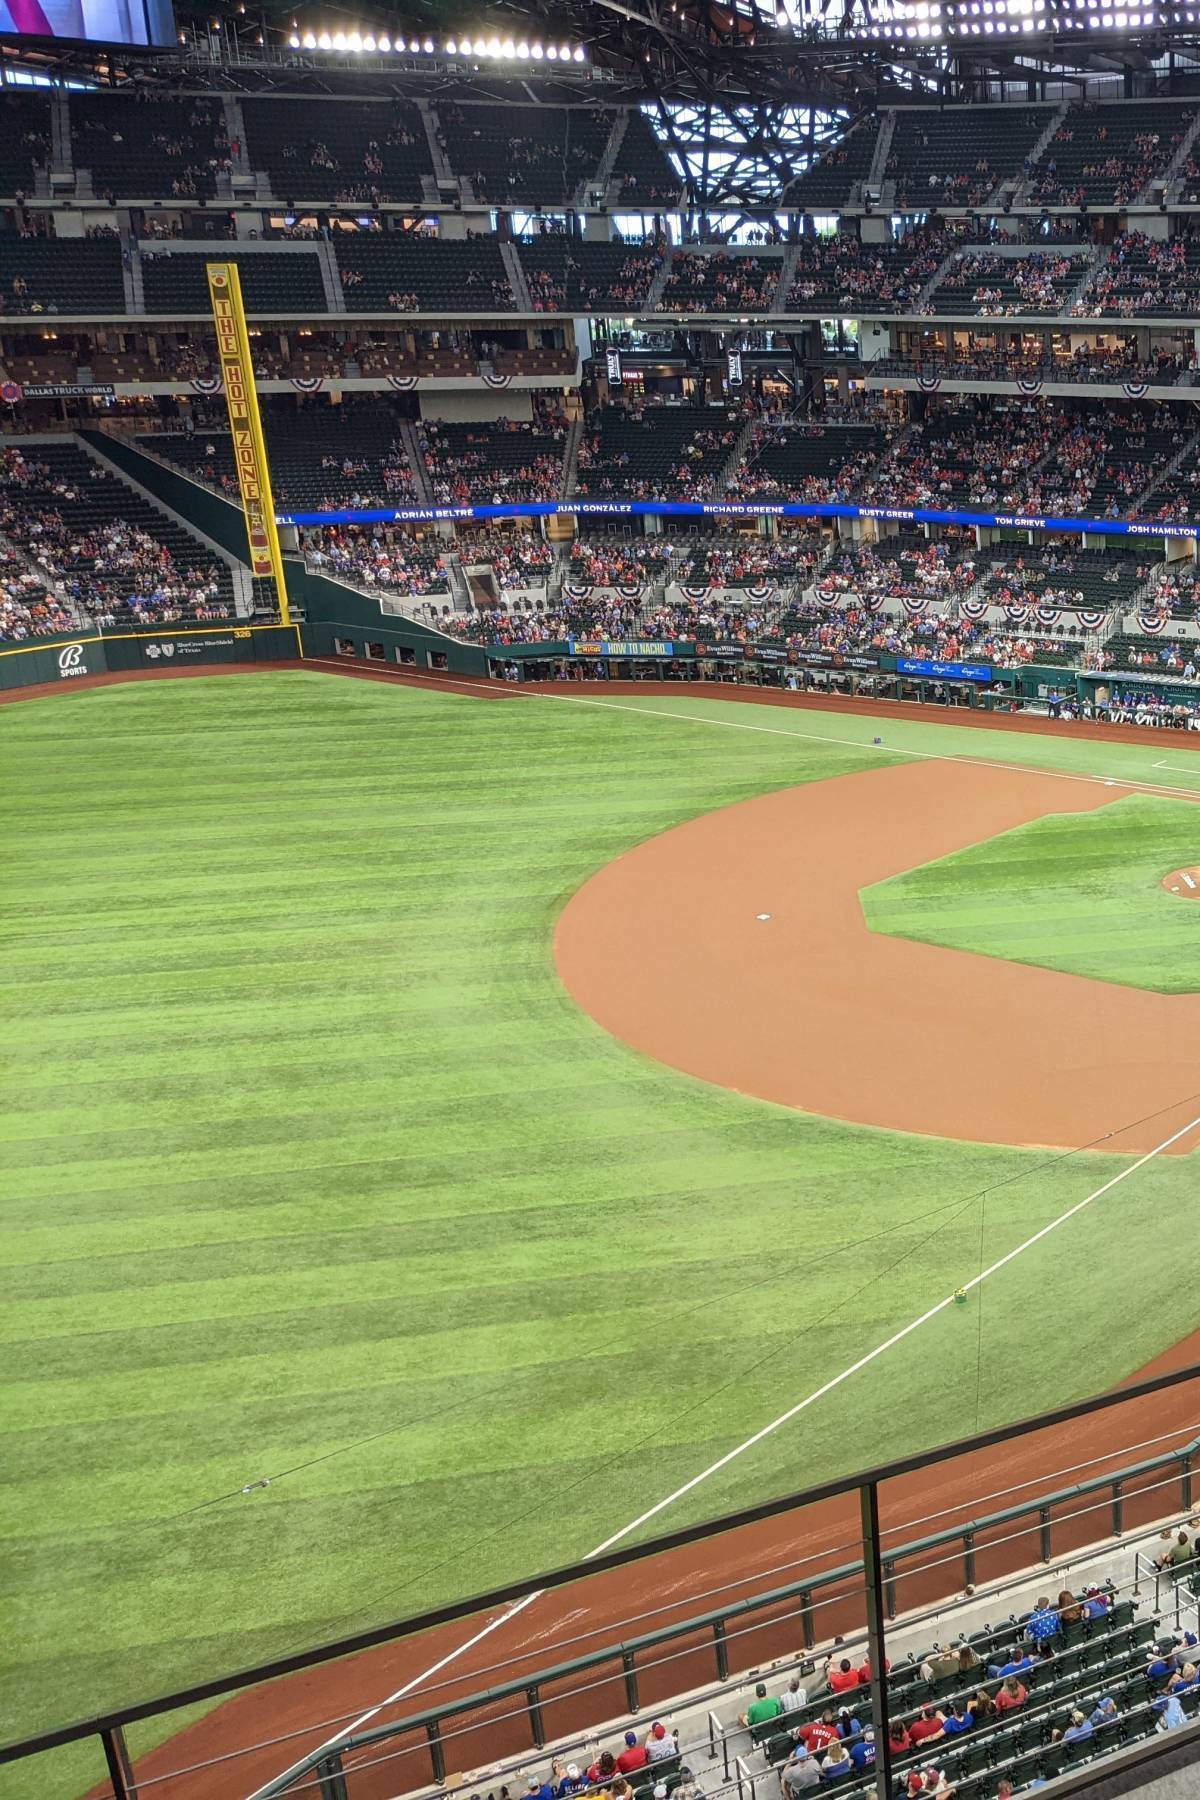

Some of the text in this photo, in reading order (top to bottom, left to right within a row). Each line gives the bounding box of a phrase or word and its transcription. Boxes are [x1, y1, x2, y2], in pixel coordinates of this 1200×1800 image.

[607, 354, 615, 378] TRULY
[728, 355, 736, 379] TRULY
[23, 387, 53, 396] DALLAS
[53, 386, 84, 395] TRUCK
[85, 386, 113, 394] WORLD
[217, 300, 257, 498] THE HOT ZONE
[556, 504, 581, 512] JUAN
[703, 505, 785, 514] RICHARD GREENE
[859, 508, 914, 519] RUSTY GREER
[995, 517, 1046, 527] TOM GRIEVE
[1126, 525, 1197, 537] JOSH HAMILTON
[234, 630, 252, 639] 326
[608, 642, 626, 654] HOW
[629, 642, 638, 654] TO
[60, 666, 87, 678] SPORTS
